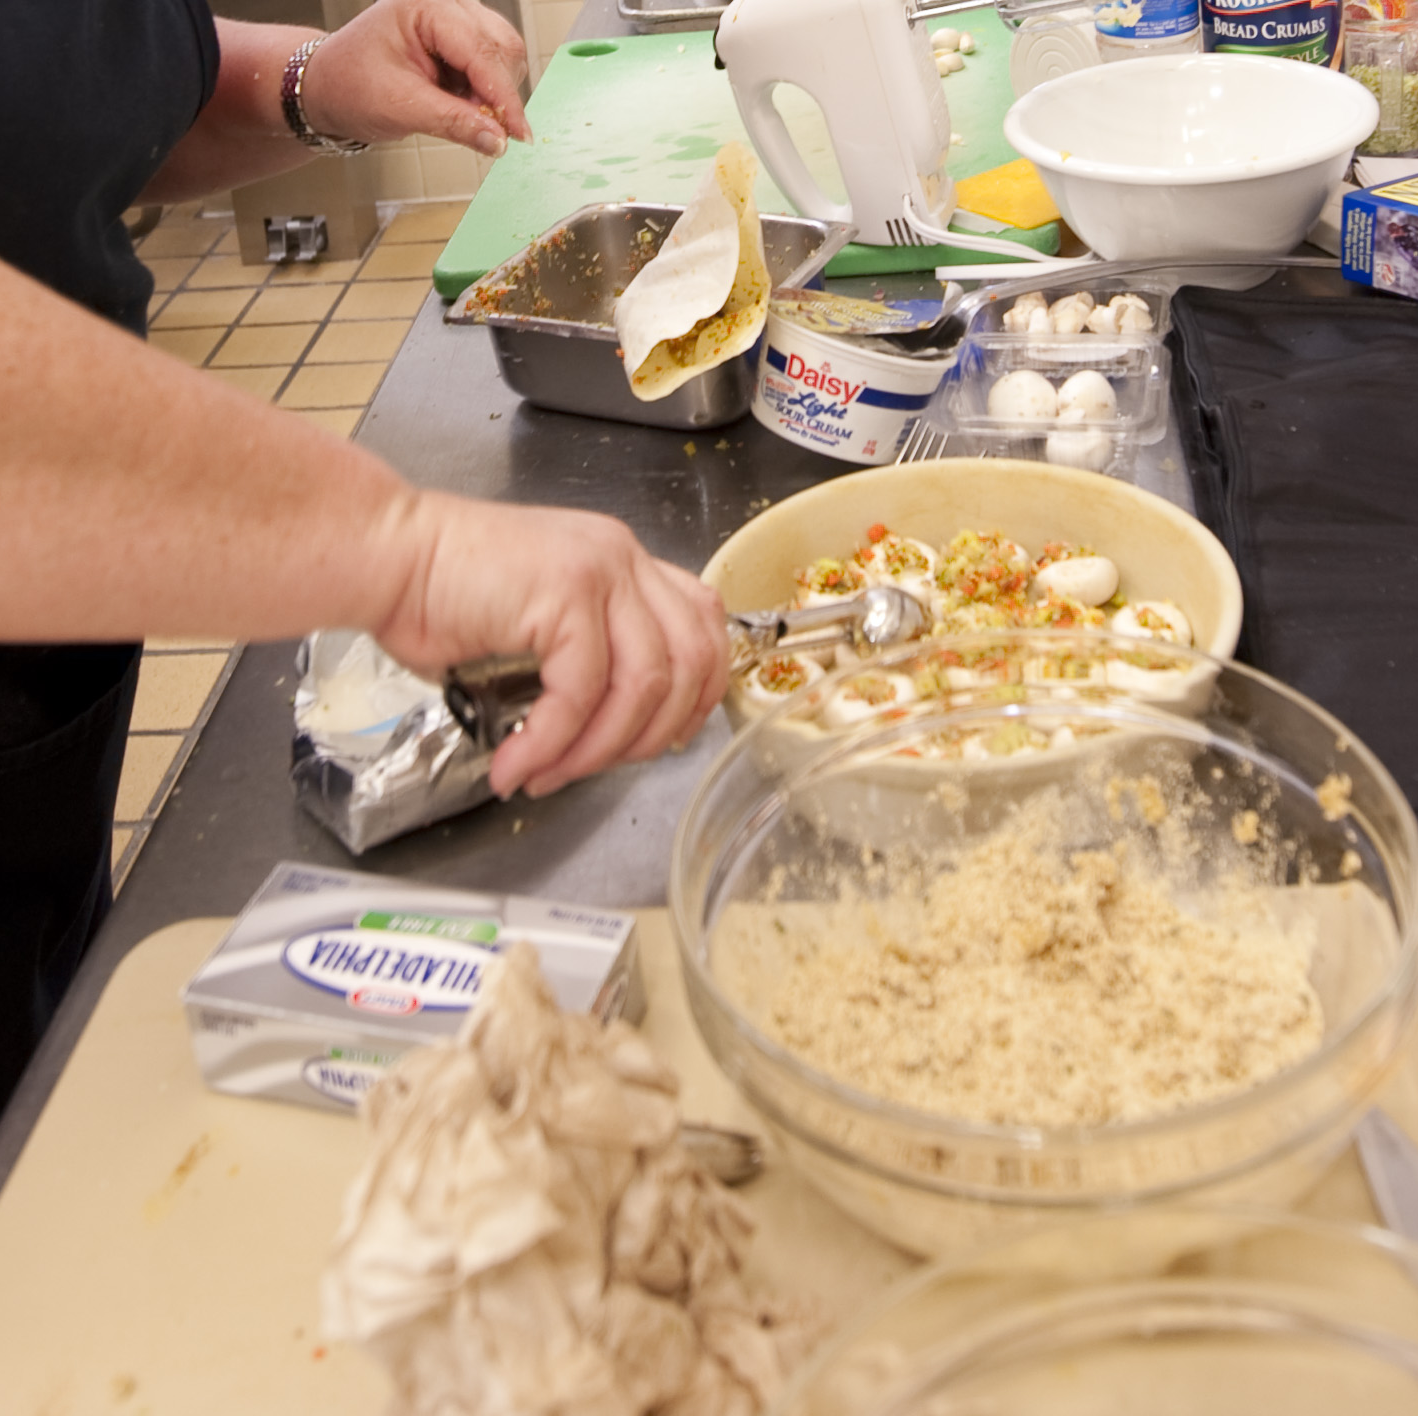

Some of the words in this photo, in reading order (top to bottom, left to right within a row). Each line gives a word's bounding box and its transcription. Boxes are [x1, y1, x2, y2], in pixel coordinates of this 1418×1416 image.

[1213, 16, 1258, 40] BREAD
[1261, 16, 1327, 40] CRUMBS
[1282, 45, 1320, 63] TYLE
[786, 353, 861, 405] Daisy
[775, 402, 806, 425] SOUR
[807, 418, 853, 440] CREAM
[787, 391, 848, 420] Light
[309, 938, 481, 993] HILADELPHIA
